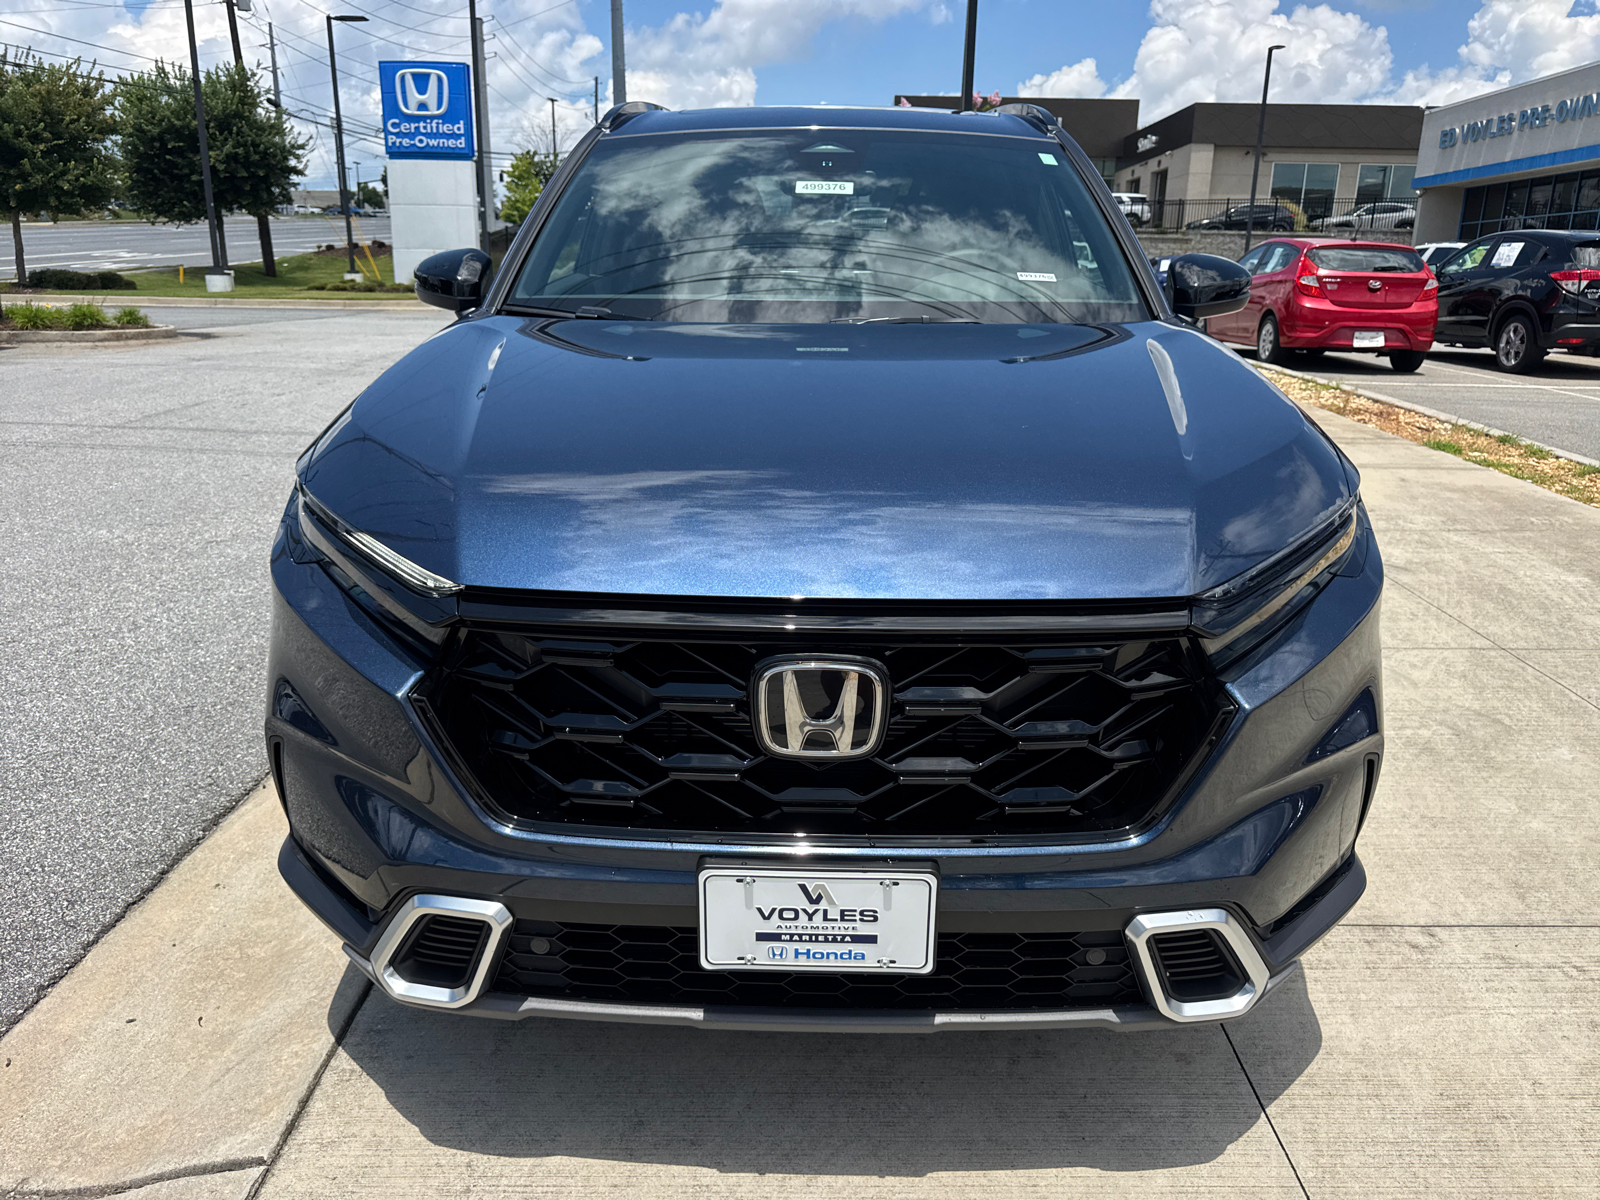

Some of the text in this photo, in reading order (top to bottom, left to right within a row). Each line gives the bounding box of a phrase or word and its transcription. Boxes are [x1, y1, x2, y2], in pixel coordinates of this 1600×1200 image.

[387, 119, 465, 134] Certified
[1439, 127, 1457, 149] ED
[1461, 112, 1516, 144] VOYLES
[387, 135, 466, 148] Pre-Owned
[802, 183, 846, 191] 499376
[756, 907, 879, 923] VOYLES
[781, 934, 852, 942] MARIETTA
[794, 948, 866, 961] Honda
